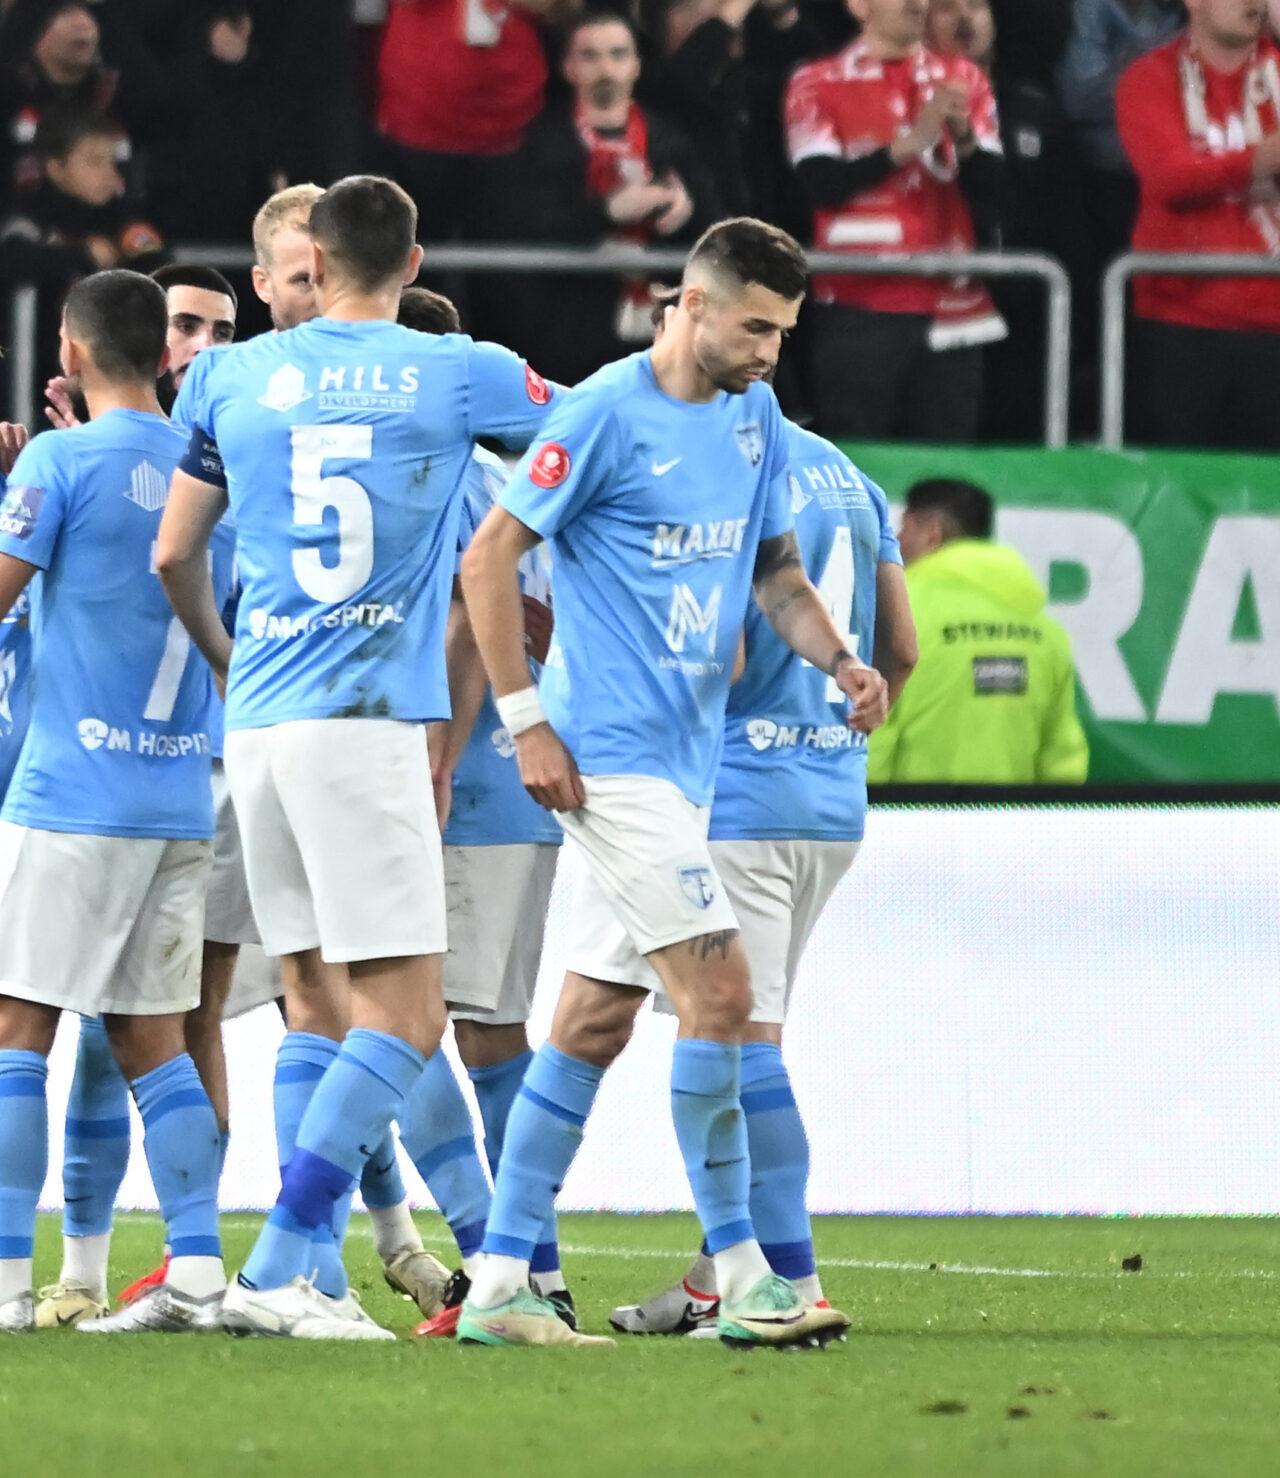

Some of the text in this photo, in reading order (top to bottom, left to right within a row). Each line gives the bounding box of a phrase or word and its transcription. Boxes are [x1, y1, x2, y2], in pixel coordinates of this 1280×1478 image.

[319, 364, 419, 393] HILS
[319, 397, 415, 408] DEVELOPMENT
[291, 424, 374, 604] 5
[107, 727, 132, 753] M
[775, 726, 800, 748] M
